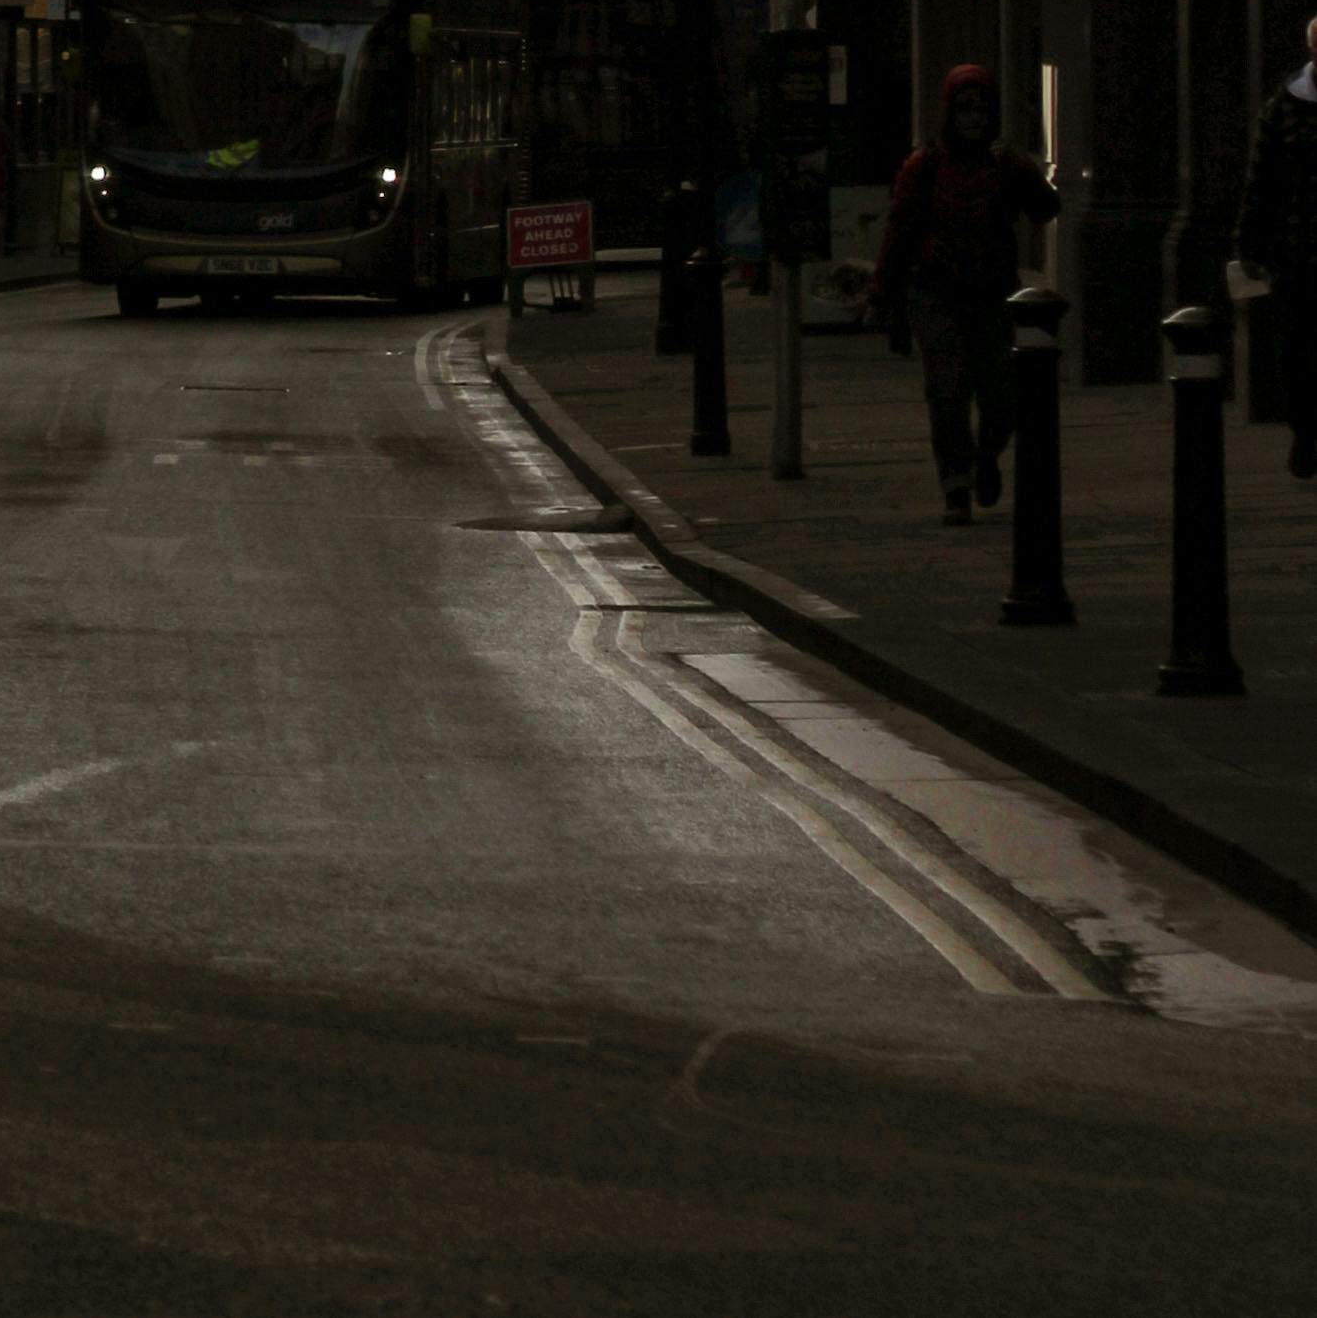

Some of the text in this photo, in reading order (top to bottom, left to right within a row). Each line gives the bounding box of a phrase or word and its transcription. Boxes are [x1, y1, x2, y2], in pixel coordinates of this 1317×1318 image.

[514, 212, 582, 229] FOOTWAY
[524, 228, 574, 242] AHEAD
[520, 242, 579, 257] CLOSED
